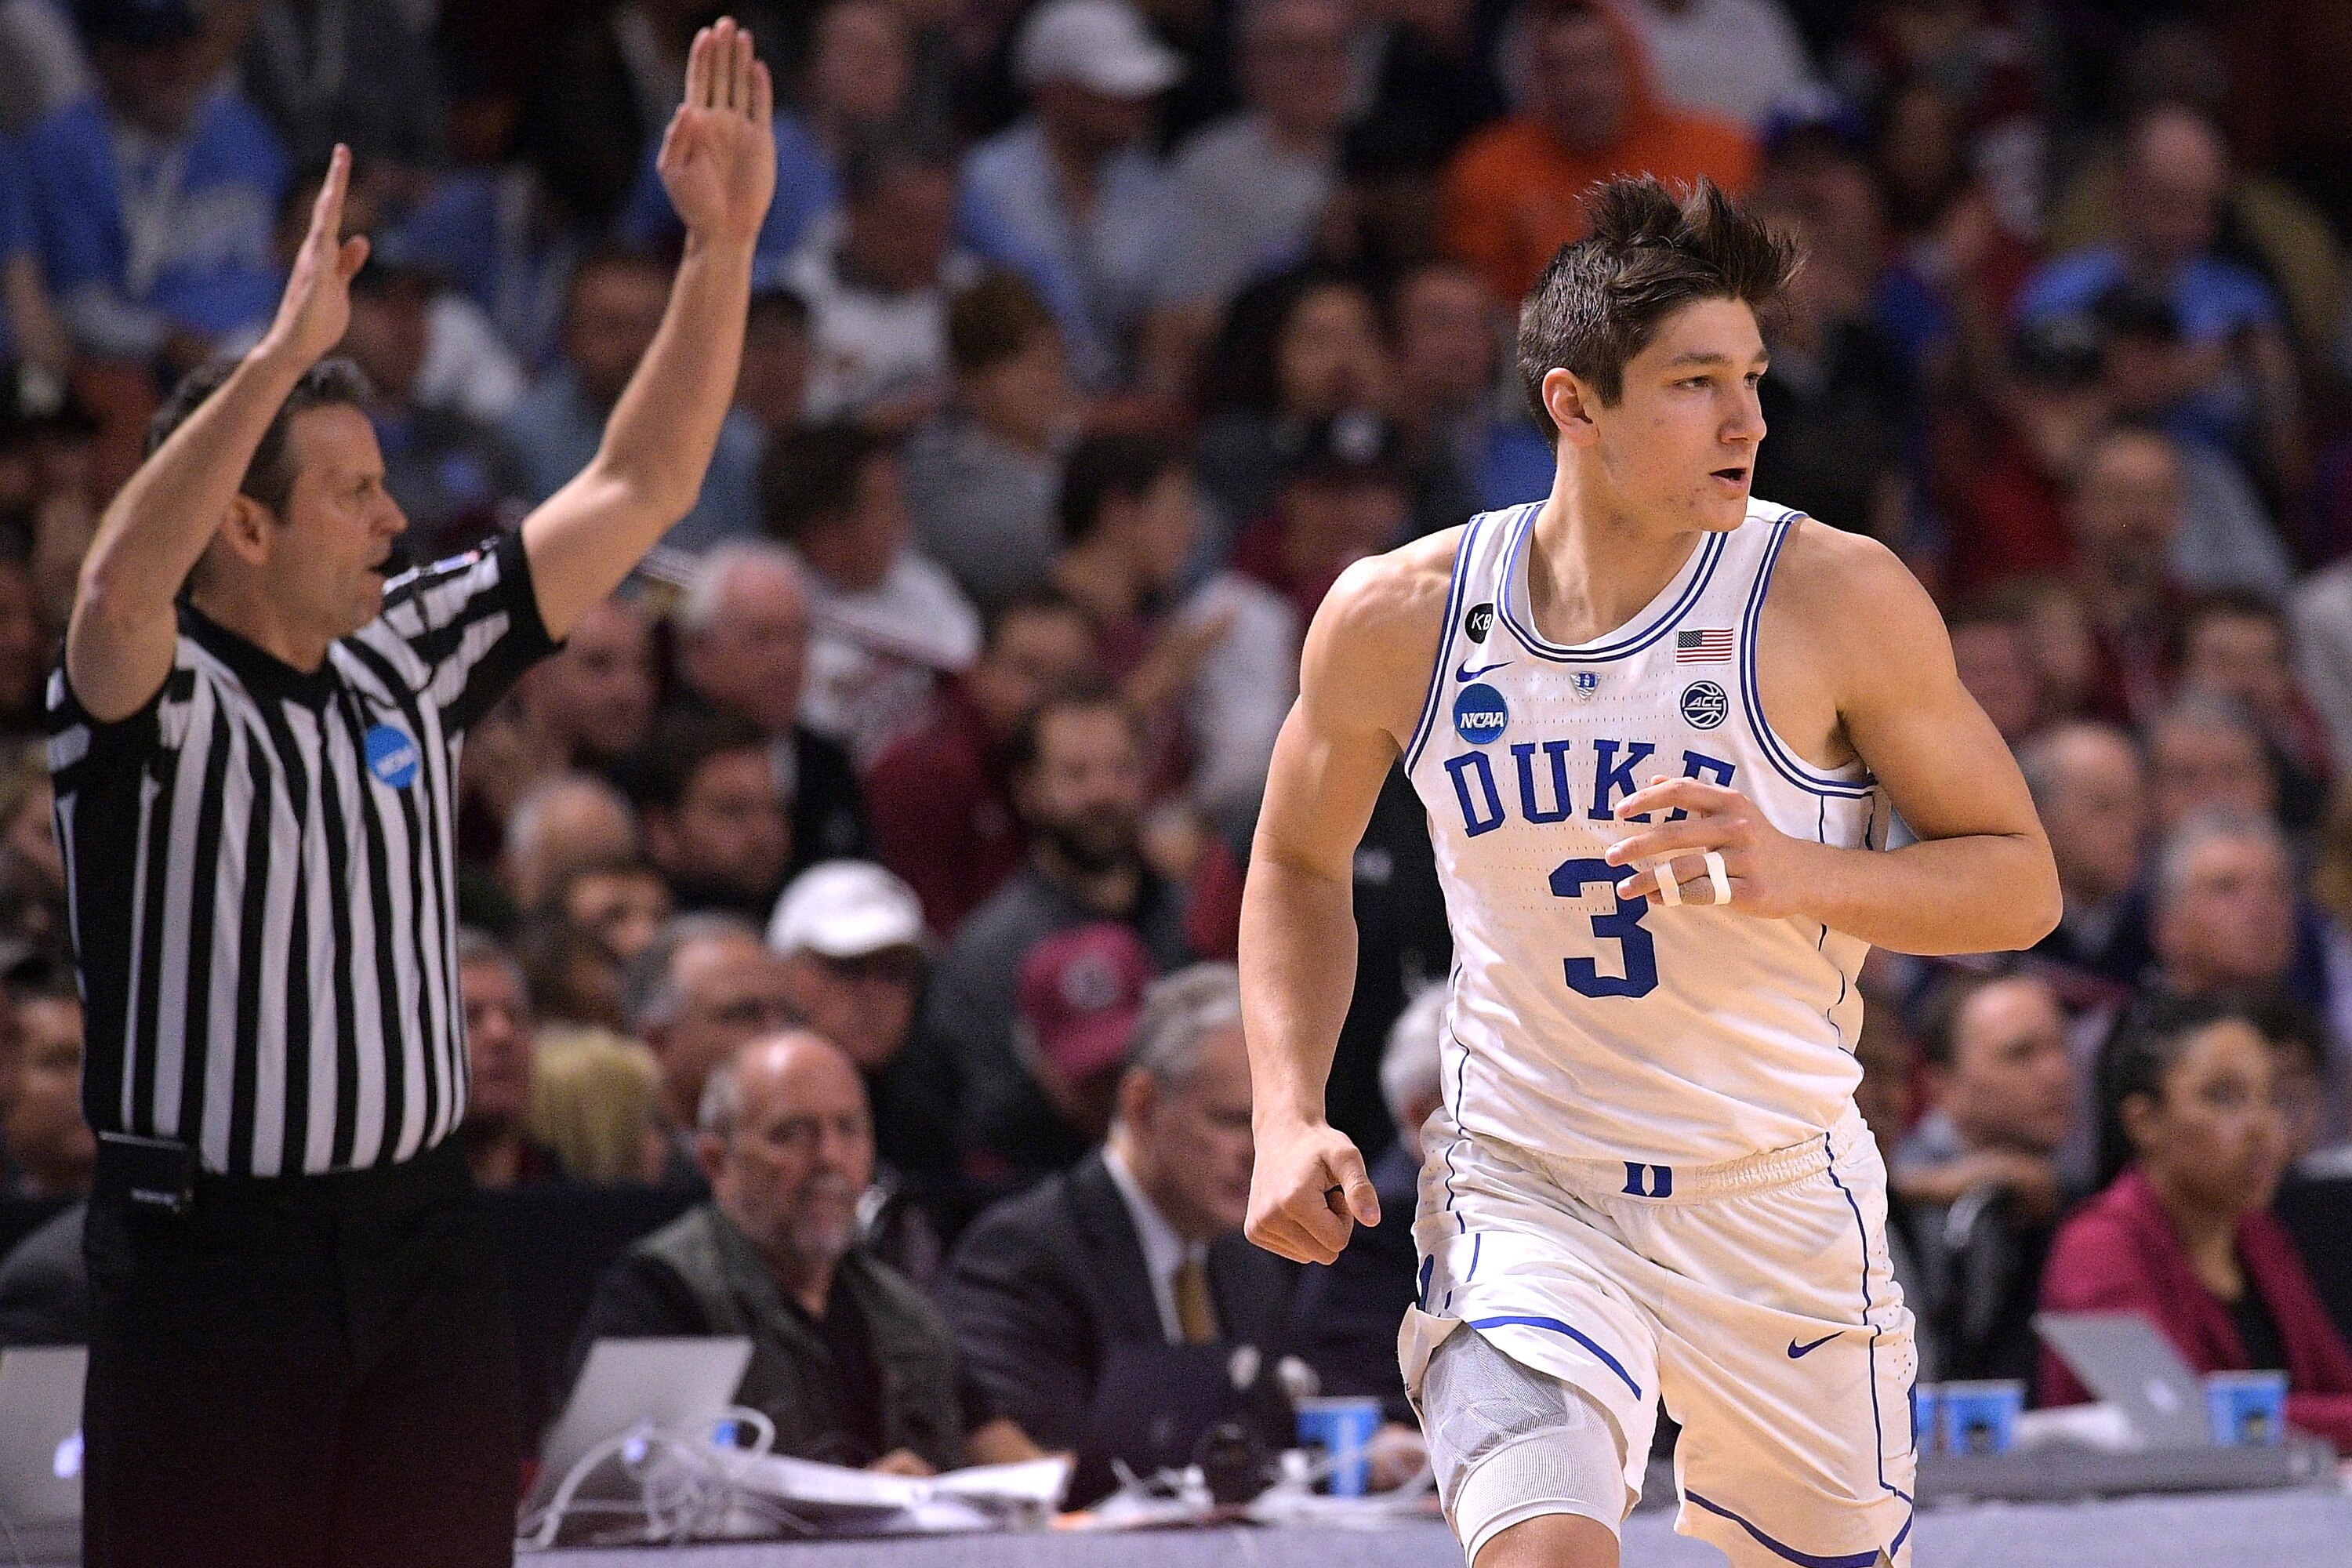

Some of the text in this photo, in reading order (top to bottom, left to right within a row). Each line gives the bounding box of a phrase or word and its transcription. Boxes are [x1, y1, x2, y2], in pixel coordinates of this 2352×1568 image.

[1472, 612, 1492, 630] KB
[1687, 696, 1725, 707] ACC
[1460, 711, 1504, 729] NCAA
[1548, 858, 1659, 998] 3
